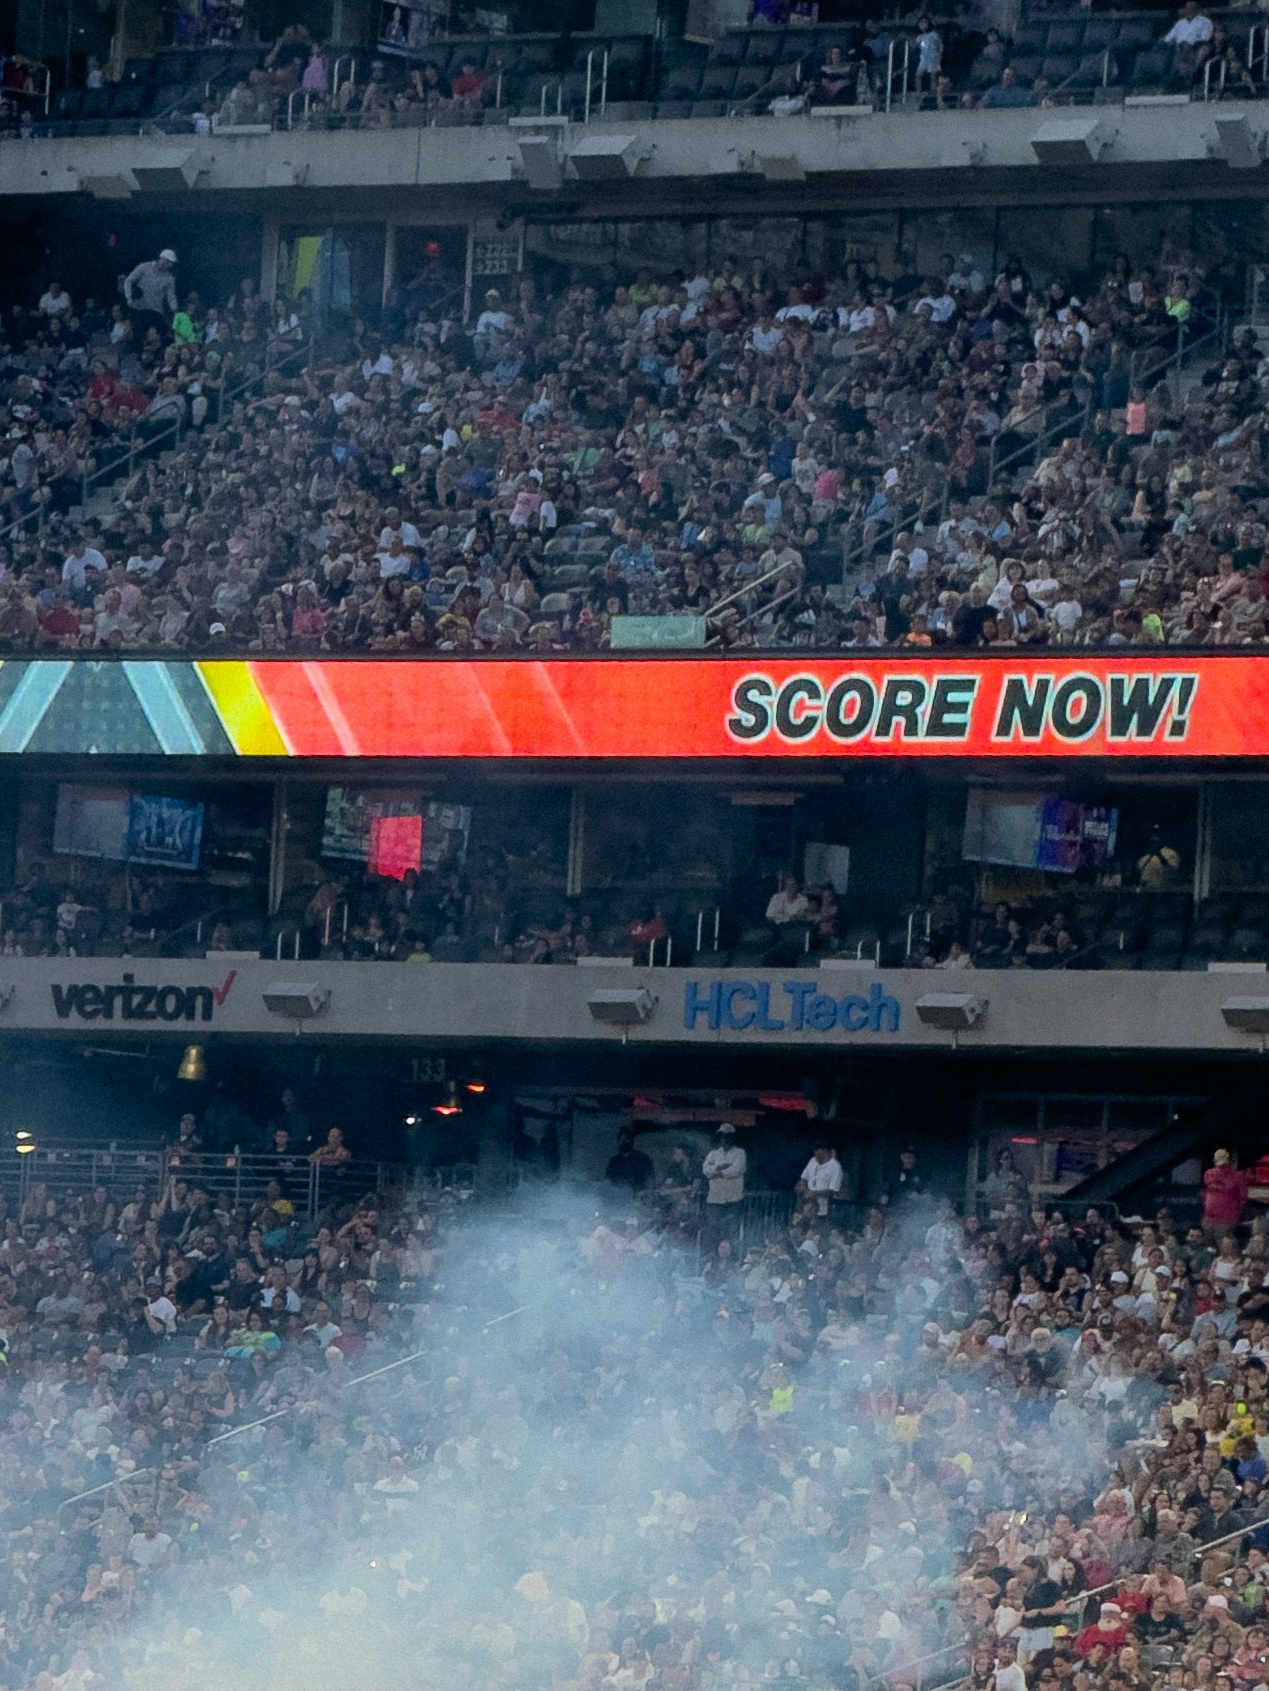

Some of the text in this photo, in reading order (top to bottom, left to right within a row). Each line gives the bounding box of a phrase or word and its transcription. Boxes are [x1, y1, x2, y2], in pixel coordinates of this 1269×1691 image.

[725, 673, 1200, 745] SCORE NOW!
[51, 973, 213, 1022] verizon
[684, 980, 901, 1032] HCLTech
